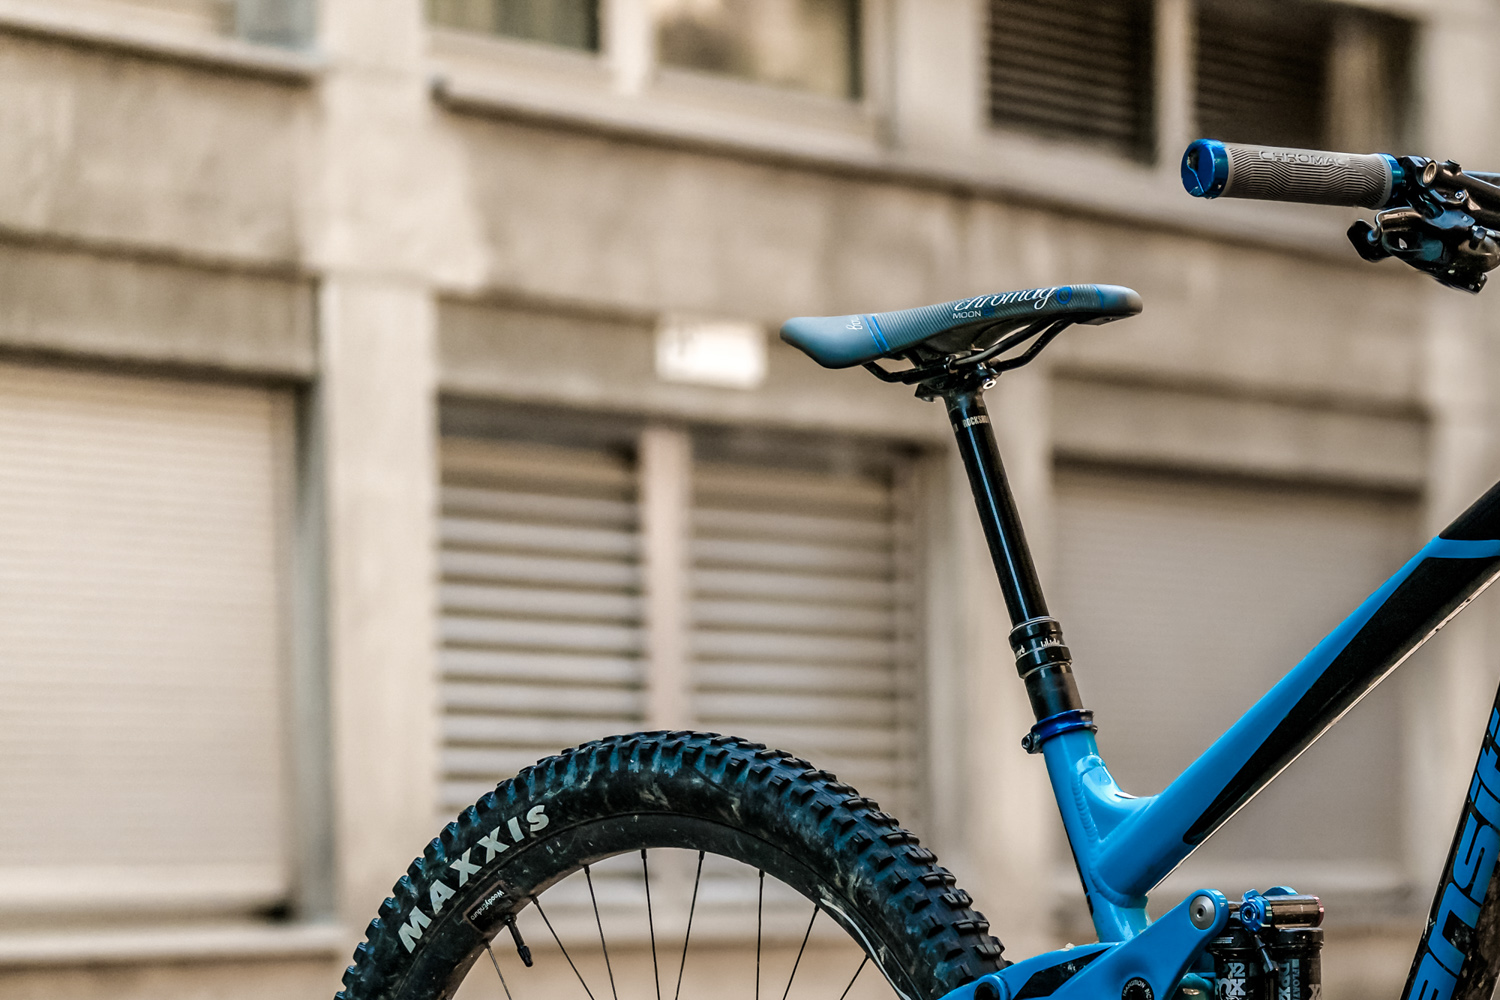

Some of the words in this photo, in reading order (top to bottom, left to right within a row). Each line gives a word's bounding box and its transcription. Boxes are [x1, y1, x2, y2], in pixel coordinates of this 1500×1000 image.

[954, 286, 1058, 311] chromag
[952, 310, 982, 320] MOON
[398, 804, 549, 953] MAXXIS
